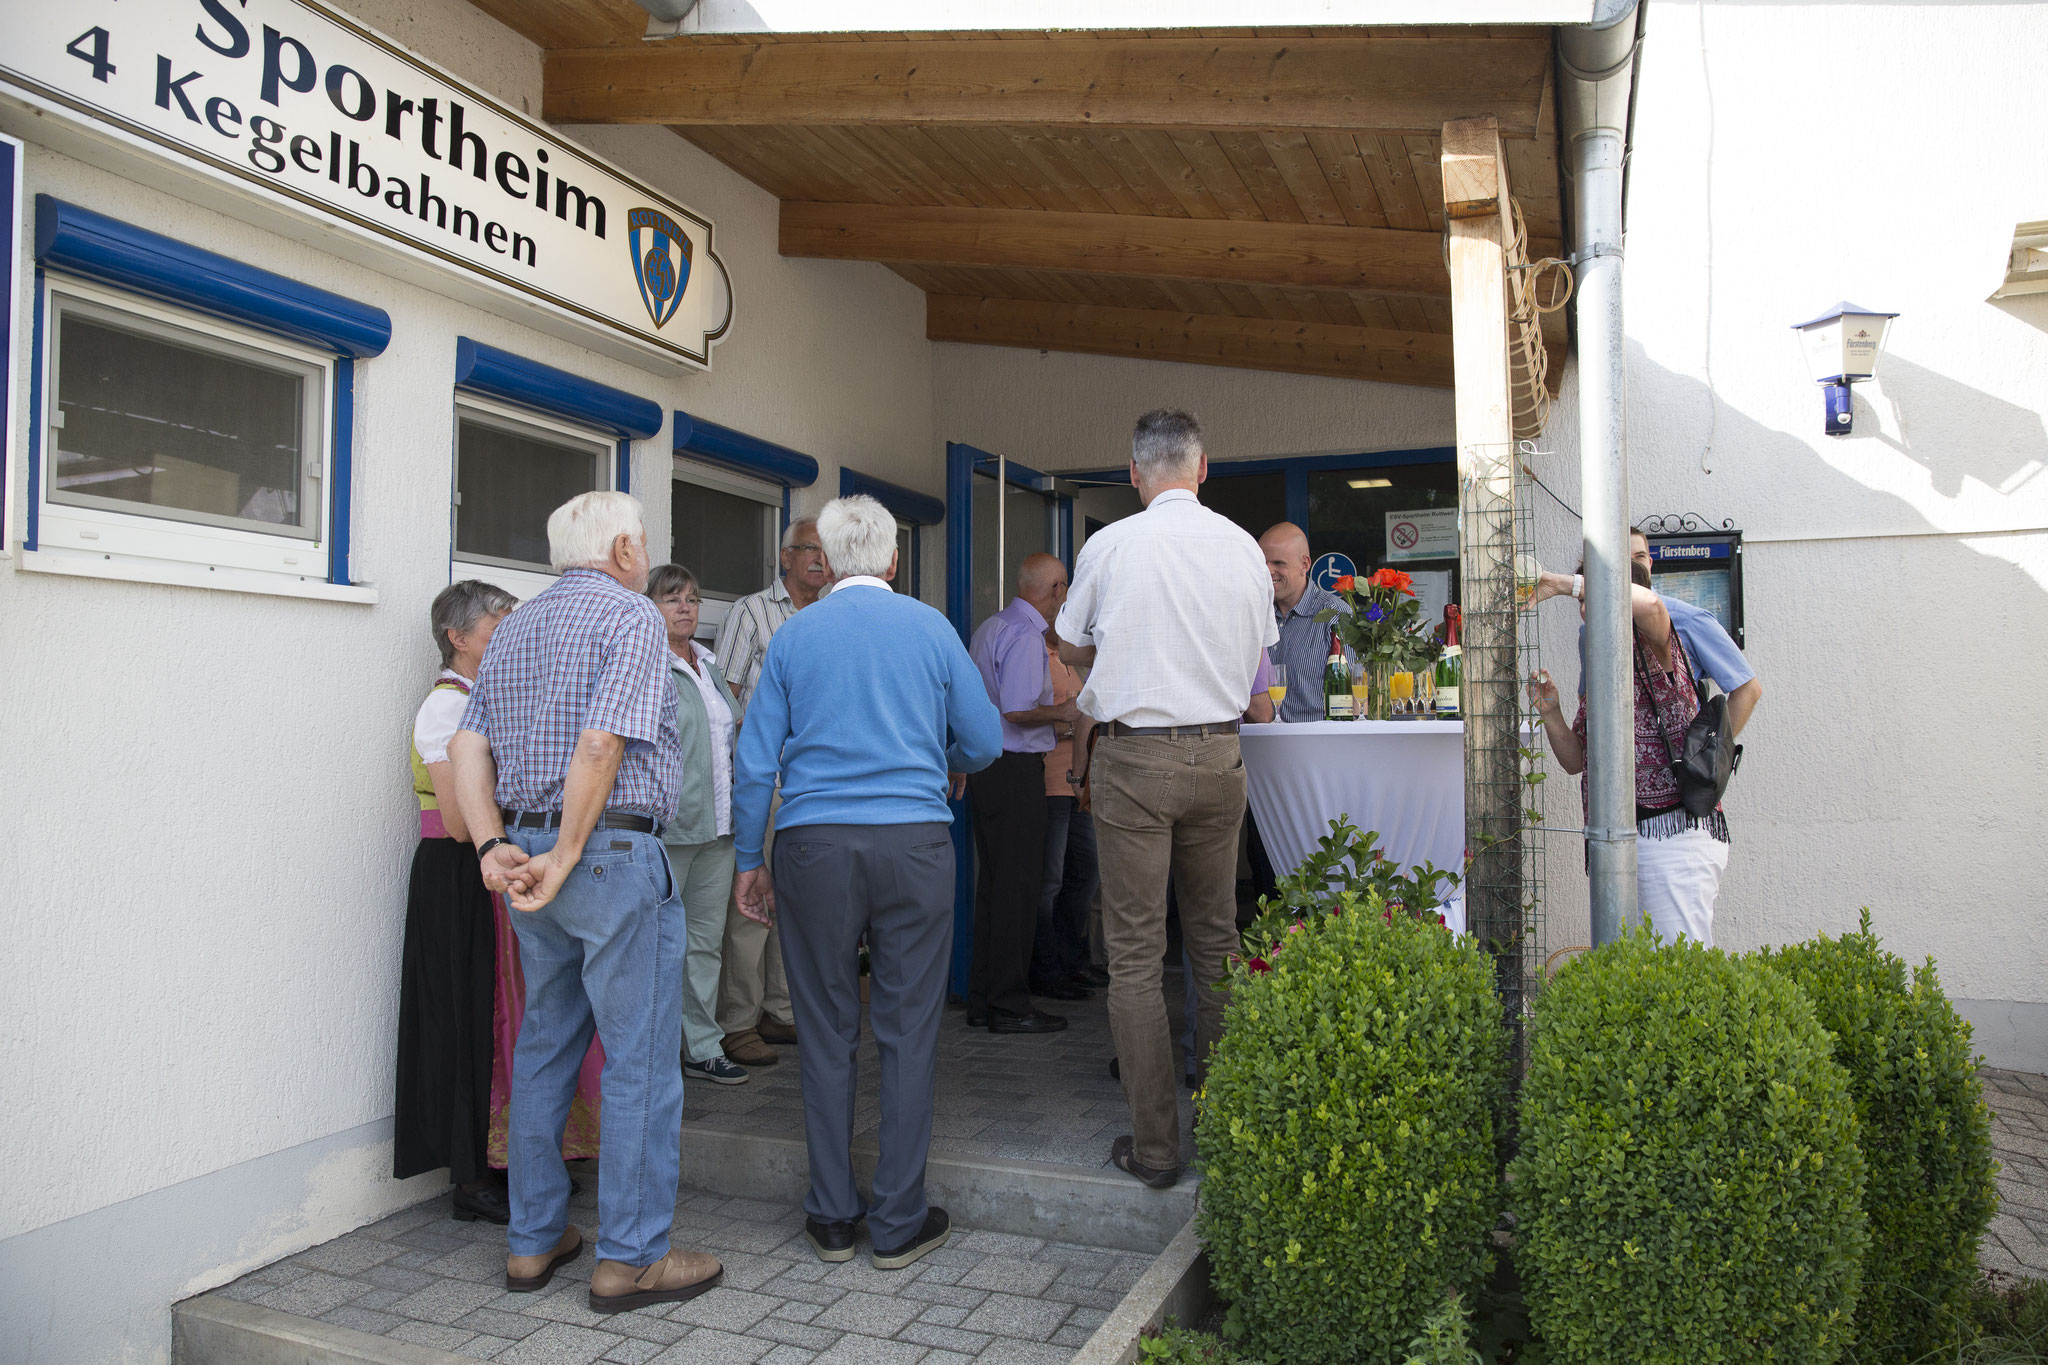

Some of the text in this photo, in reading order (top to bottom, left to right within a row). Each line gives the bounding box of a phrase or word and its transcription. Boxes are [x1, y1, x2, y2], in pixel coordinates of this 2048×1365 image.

[195, 0, 607, 241] Sportheim
[66, 26, 538, 268] 4 Kegelbahnen
[630, 210, 689, 253] ROTTWEIL
[1847, 338, 1876, 350] Fürstenberg
[1390, 512, 1430, 520] ESV-Sportheim
[1660, 545, 1710, 559] Fürstenberg
